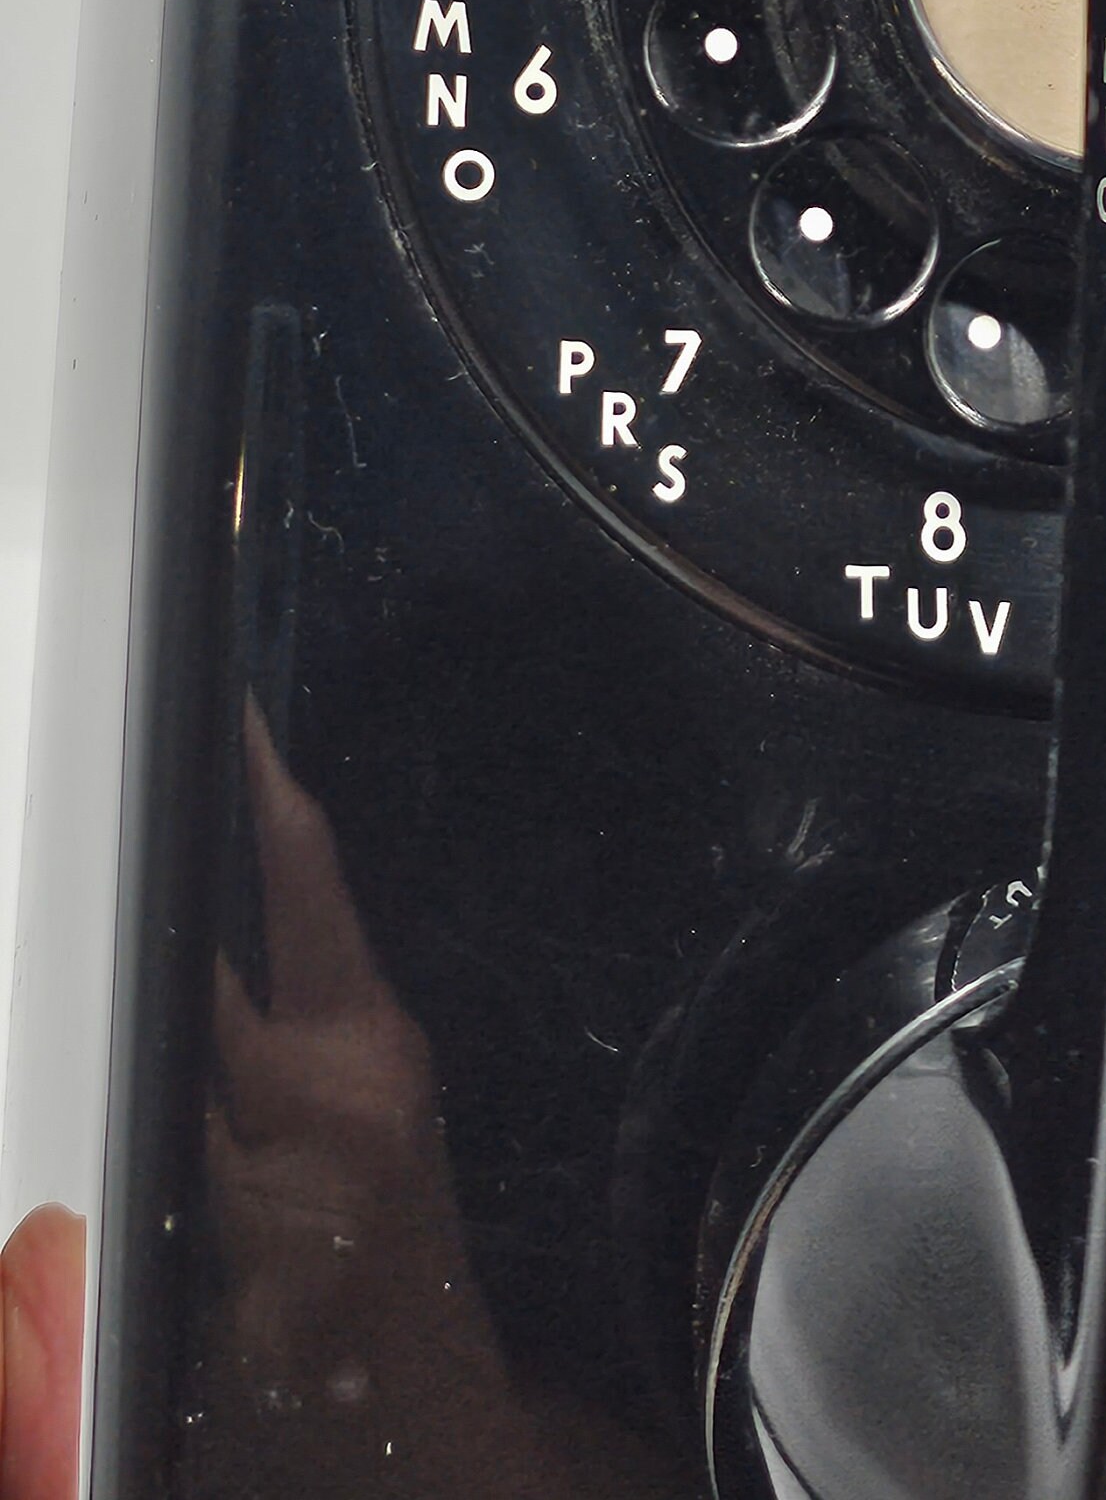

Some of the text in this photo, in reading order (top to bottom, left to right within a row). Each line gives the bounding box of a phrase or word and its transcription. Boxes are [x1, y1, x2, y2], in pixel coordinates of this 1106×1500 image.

[514, 44, 557, 114] 6
[661, 329, 702, 393] 7
[920, 491, 967, 562] 8
[845, 564, 1011, 655] TUV
